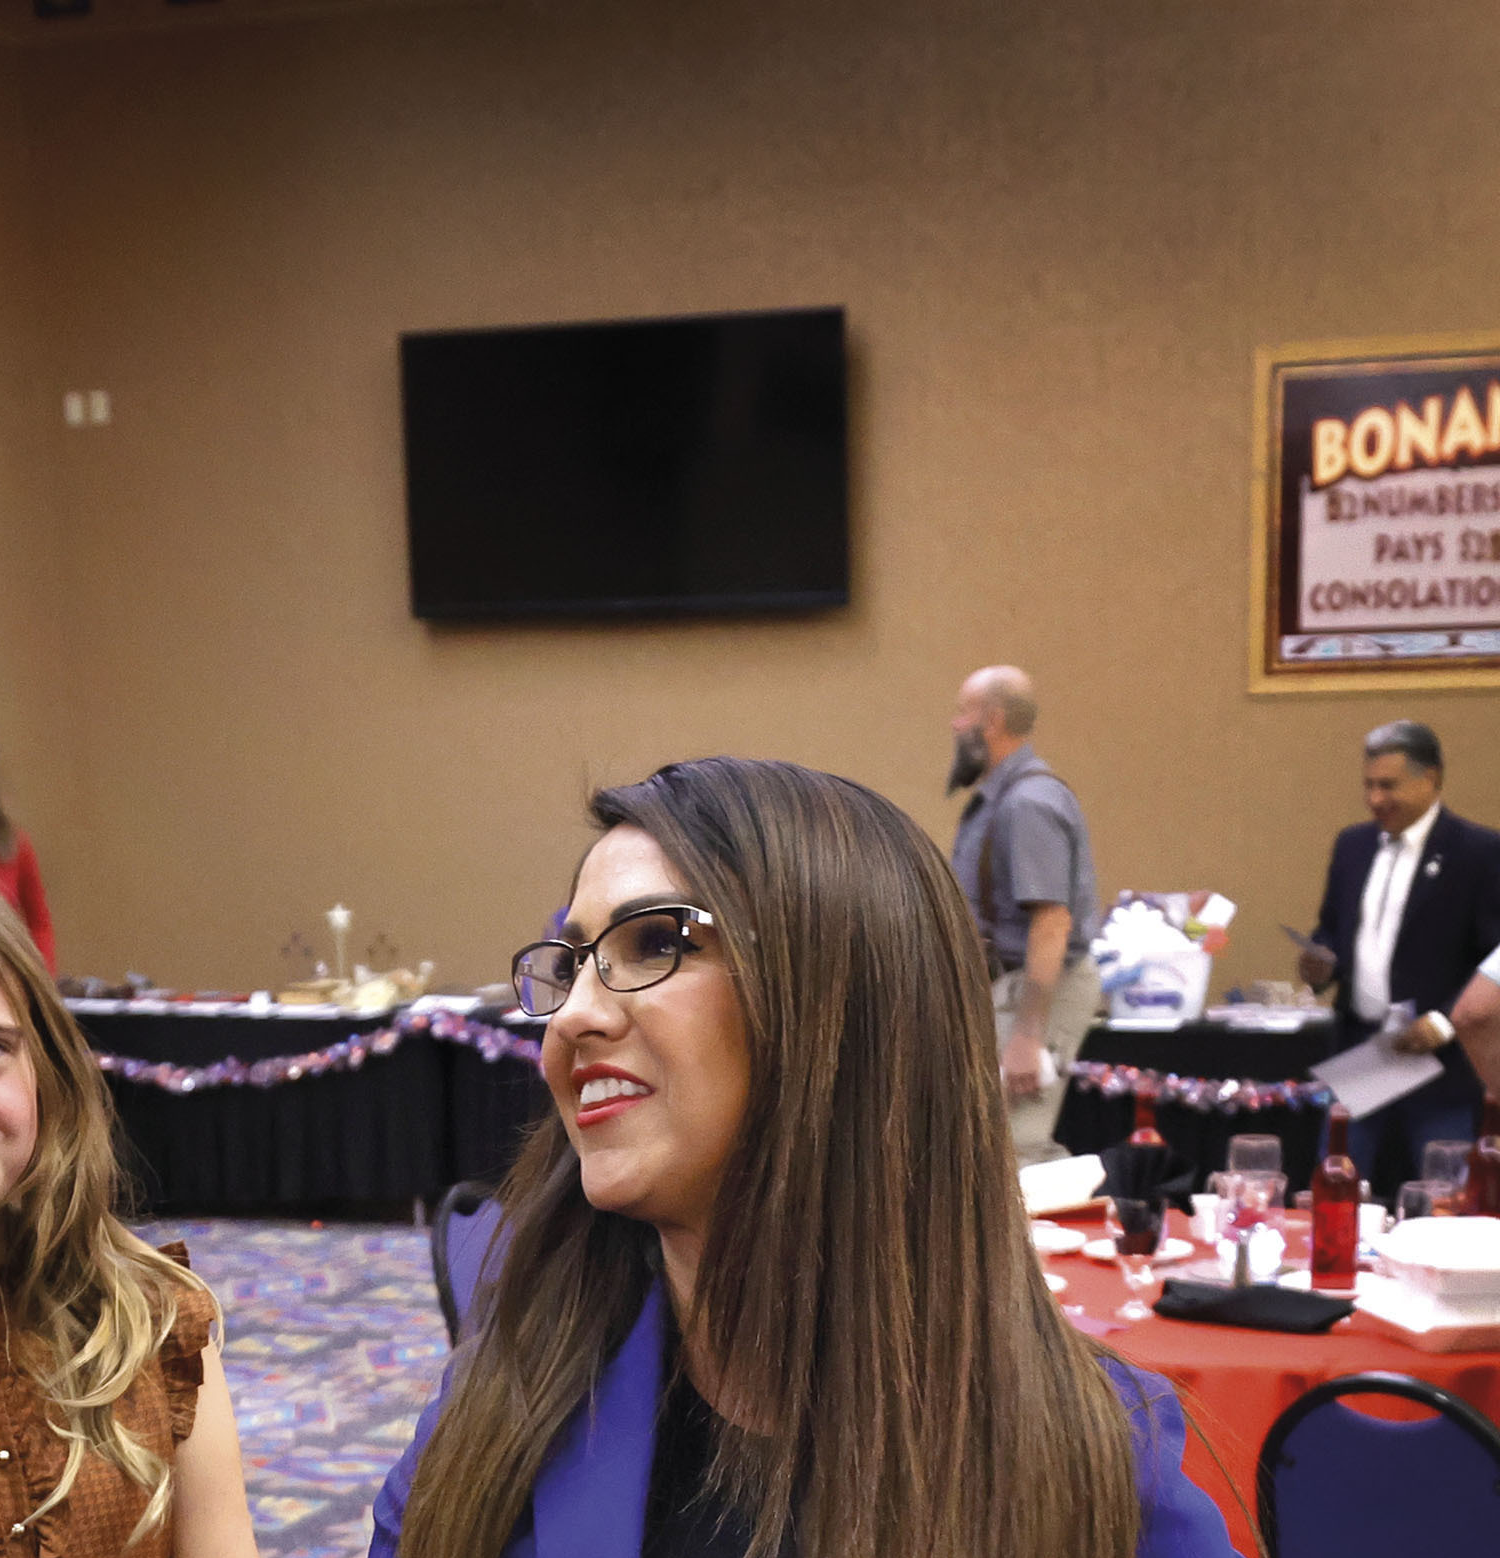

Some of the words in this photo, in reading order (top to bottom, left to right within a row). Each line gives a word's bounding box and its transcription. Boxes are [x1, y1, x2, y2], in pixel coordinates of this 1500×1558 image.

[1311, 379, 1500, 487] BONA
[1374, 531, 1444, 564] PAYS
[1309, 575, 1500, 612] CONSOLATIO
